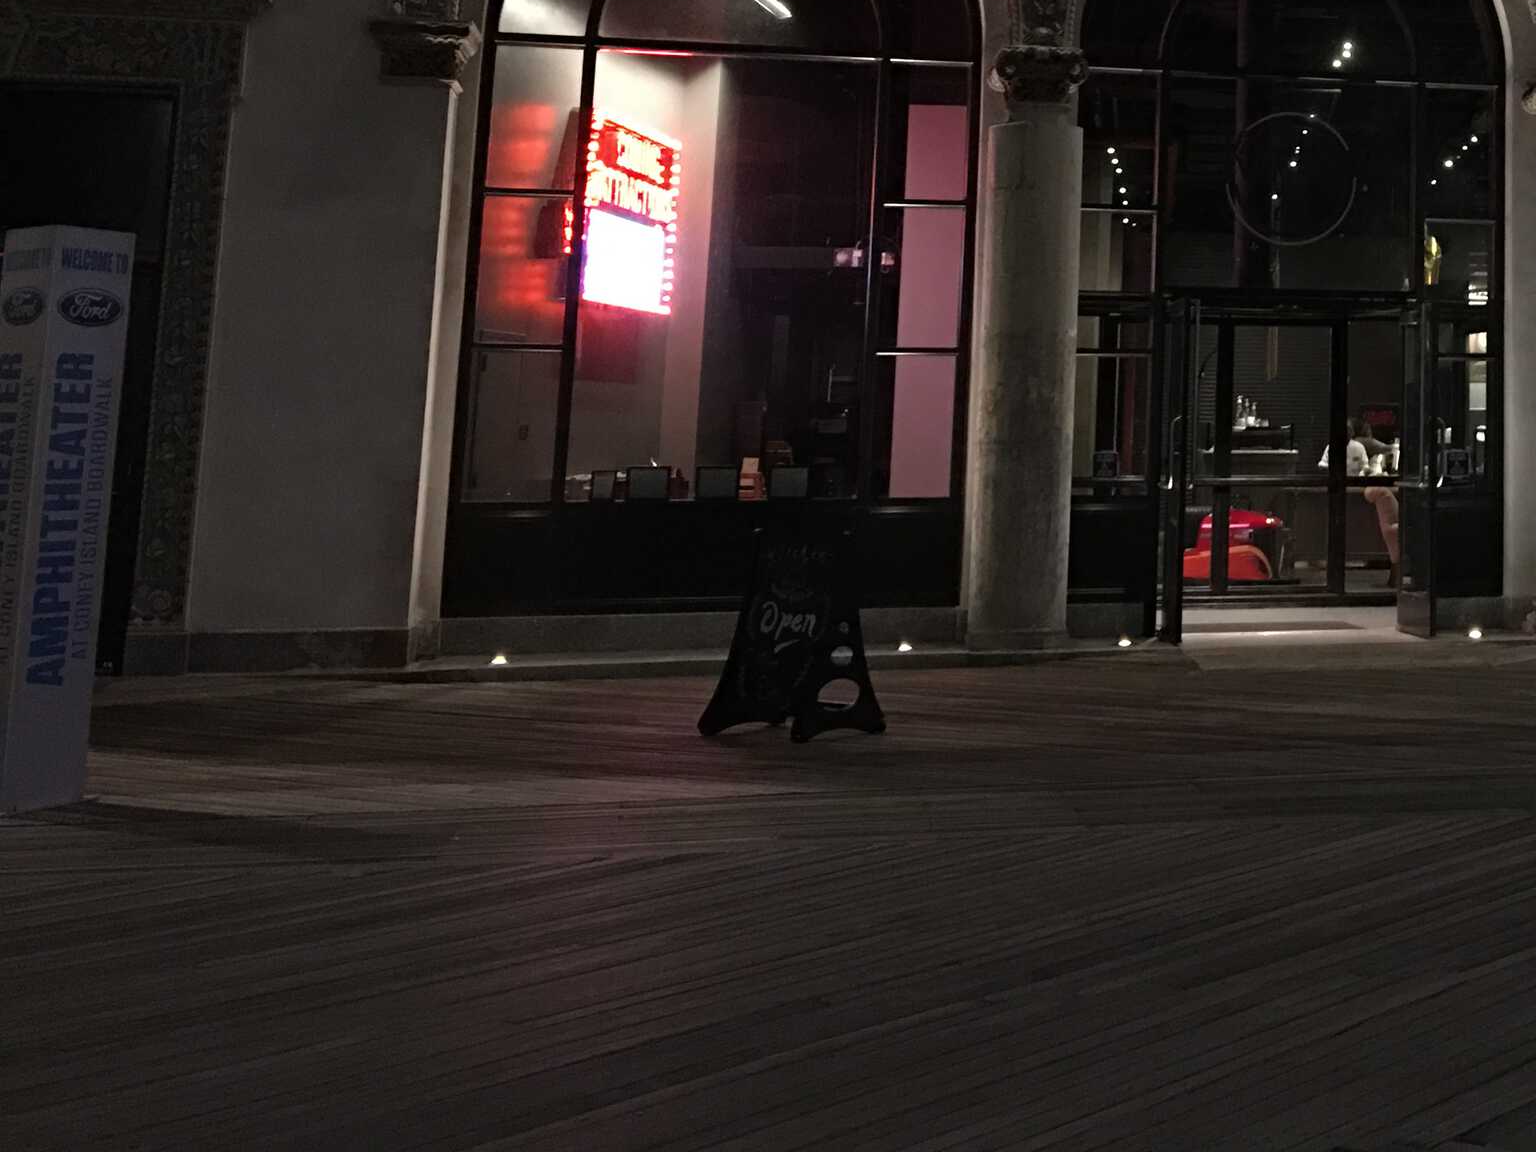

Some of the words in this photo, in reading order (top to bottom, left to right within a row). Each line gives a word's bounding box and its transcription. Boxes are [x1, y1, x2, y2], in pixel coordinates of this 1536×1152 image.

[62, 247, 113, 272] WELCOME
[116, 253, 129, 275] TO
[69, 292, 113, 320] Ford
[87, 376, 112, 492] BOARDWALK
[27, 352, 95, 686] AMPHITHEATER
[80, 498, 102, 566] ISLAND
[73, 570, 95, 632] CONEY
[759, 600, 817, 641] Open
[71, 641, 88, 660] AT
